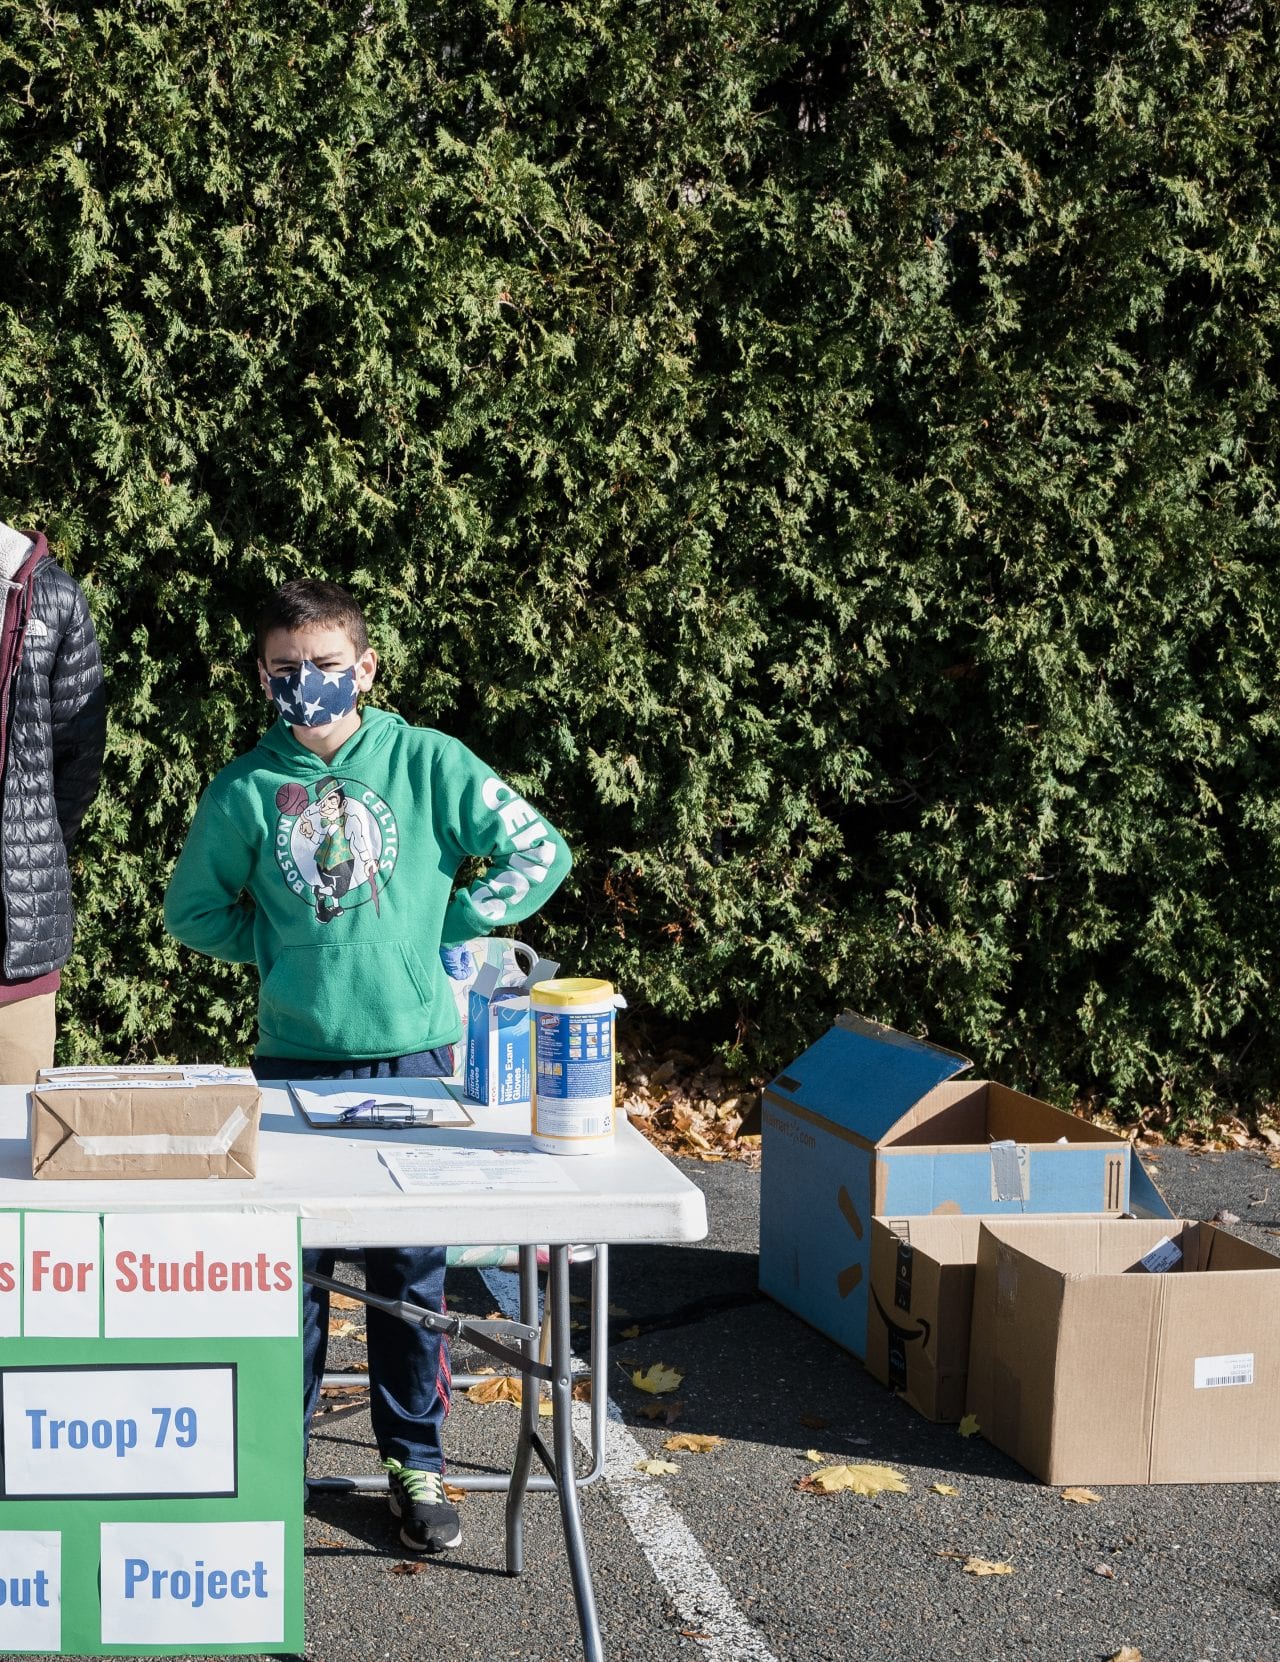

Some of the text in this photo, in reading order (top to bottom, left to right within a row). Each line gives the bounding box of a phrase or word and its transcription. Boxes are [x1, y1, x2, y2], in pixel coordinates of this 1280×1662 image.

[276, 790, 398, 895] BOSTON CELTICS
[505, 1042, 513, 1102] Nitrile Exam
[513, 1067, 522, 1100] Gloves
[31, 1250, 94, 1293] For
[115, 1250, 293, 1293] Students
[24, 1407, 199, 1458] Troop 79
[124, 1557, 269, 1609] Project
